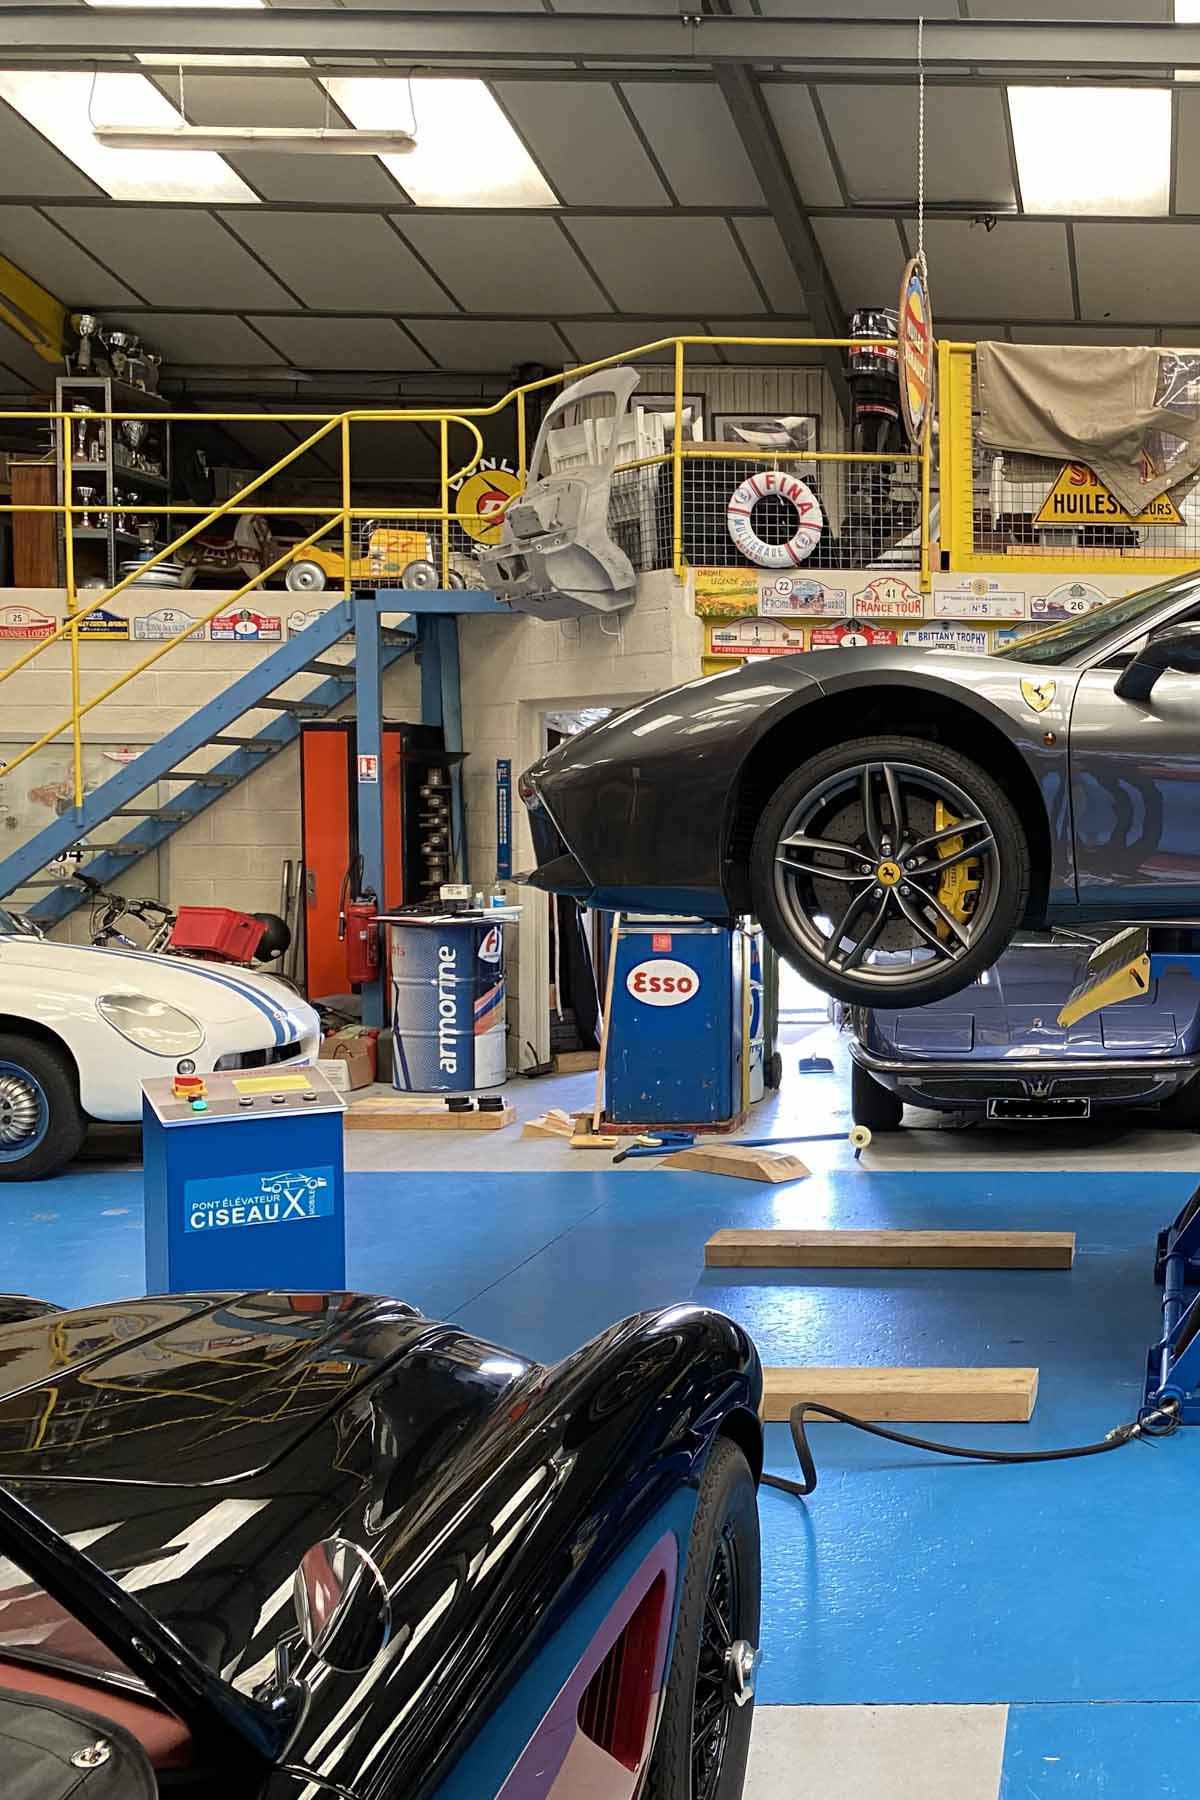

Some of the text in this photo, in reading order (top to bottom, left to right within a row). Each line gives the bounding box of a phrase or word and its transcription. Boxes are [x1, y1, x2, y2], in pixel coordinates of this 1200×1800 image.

[764, 474, 814, 517] FINA
[1054, 494, 1117, 515] HUILES
[779, 581, 789, 590] 22
[885, 589, 896, 599] 41
[856, 599, 893, 613] FRANCE
[896, 600, 920, 613] TOUR
[981, 604, 988, 613] 5
[1071, 602, 1084, 610] 26
[163, 612, 174, 622] 22
[849, 637, 856, 646] 4
[918, 632, 955, 641] BRITTANY
[957, 632, 986, 645] TROPHY
[438, 946, 457, 1074] armorine
[192, 1193, 281, 1211] PONT ÉLÉVATEUR
